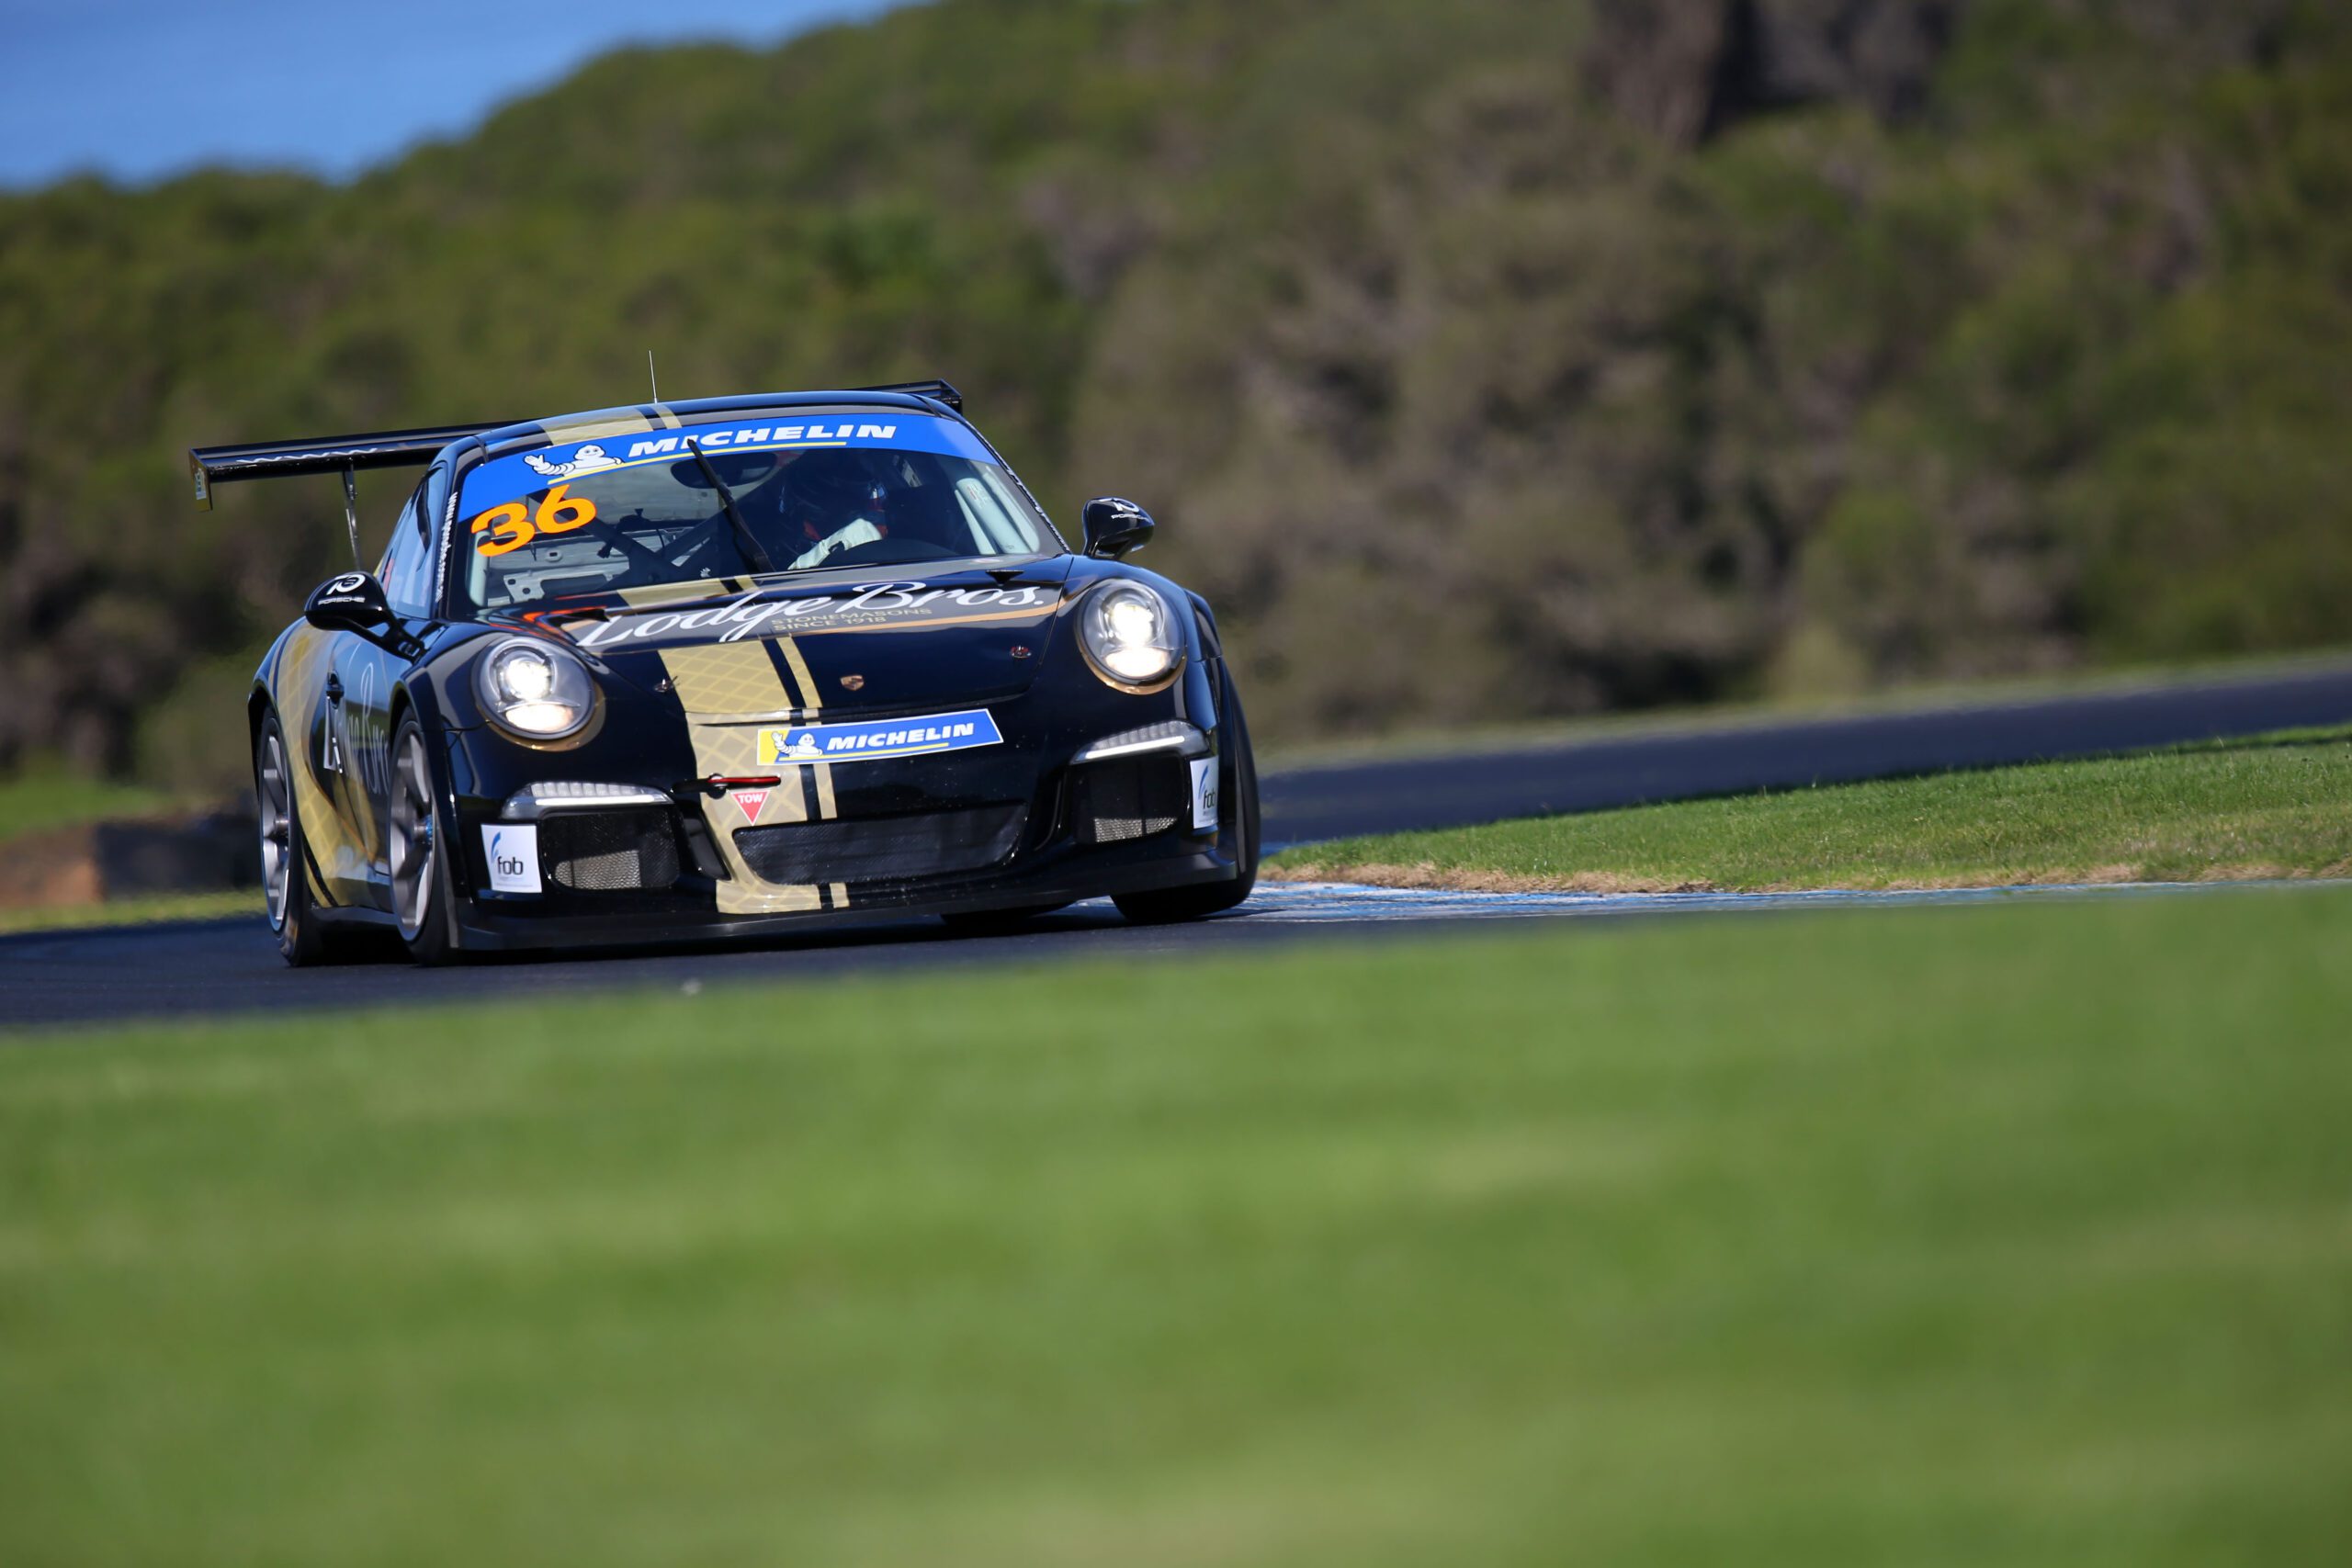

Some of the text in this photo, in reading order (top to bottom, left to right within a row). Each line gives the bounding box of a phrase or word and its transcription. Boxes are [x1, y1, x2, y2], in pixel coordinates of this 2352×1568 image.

[628, 424, 897, 457] MICHELIN
[470, 483, 597, 558] 36
[576, 581, 1045, 644] Lodge Bros.
[771, 607, 933, 626] STONEMASONS
[773, 619, 837, 631] SINCE
[827, 723, 974, 750] MICHELIN
[738, 793, 763, 804] TOW
[497, 855, 524, 875] fob
